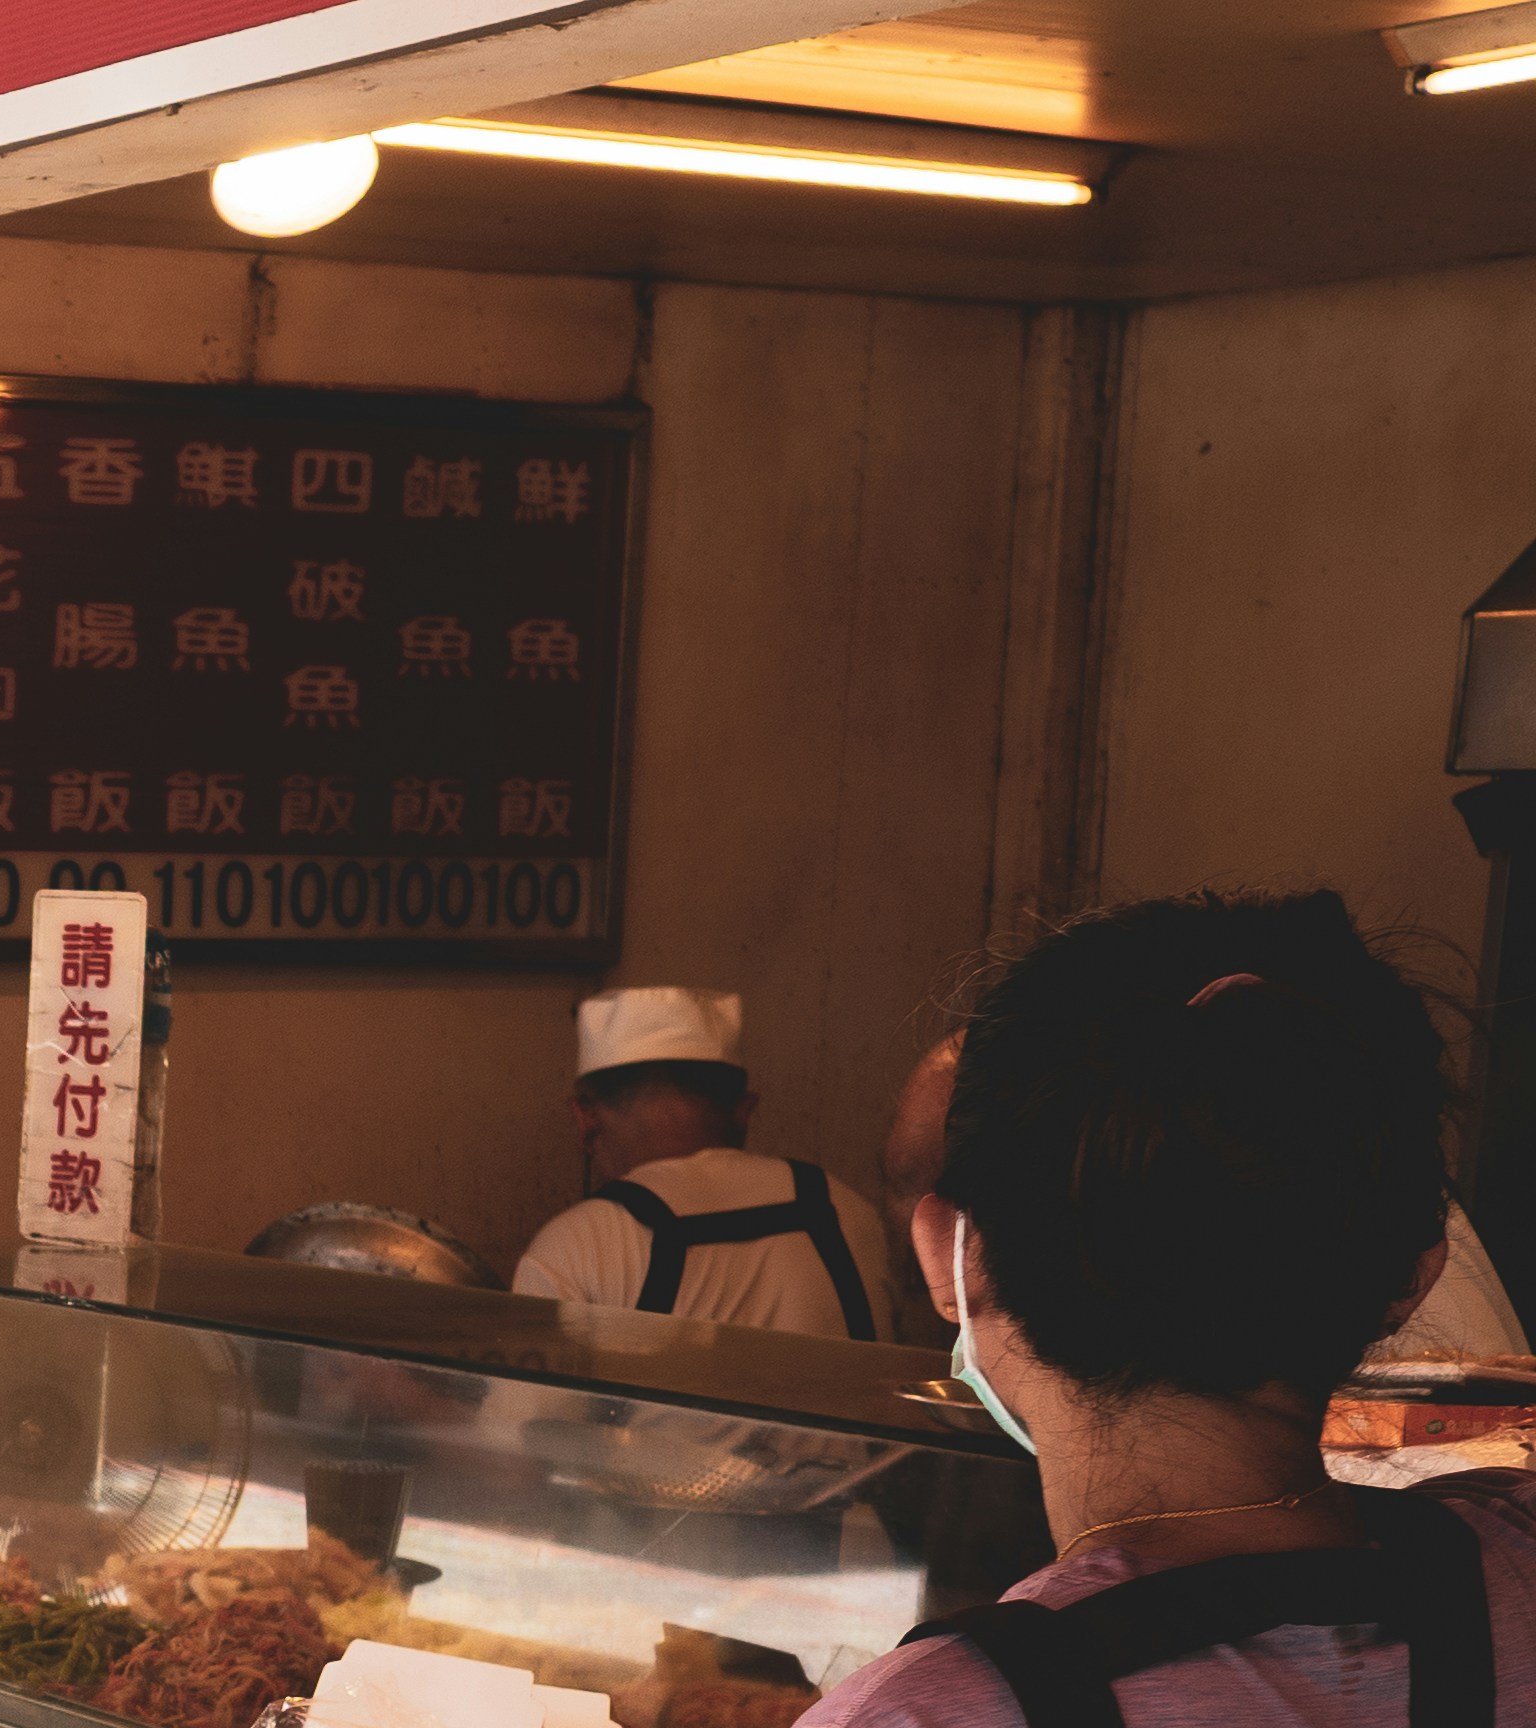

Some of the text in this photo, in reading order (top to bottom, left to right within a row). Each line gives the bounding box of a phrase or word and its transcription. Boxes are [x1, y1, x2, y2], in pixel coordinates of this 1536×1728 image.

[154, 859, 253, 927] 110
[264, 860, 369, 929] 100
[369, 860, 473, 929] 100
[481, 861, 581, 929] 100
[47, 922, 114, 1214] 請先付款
